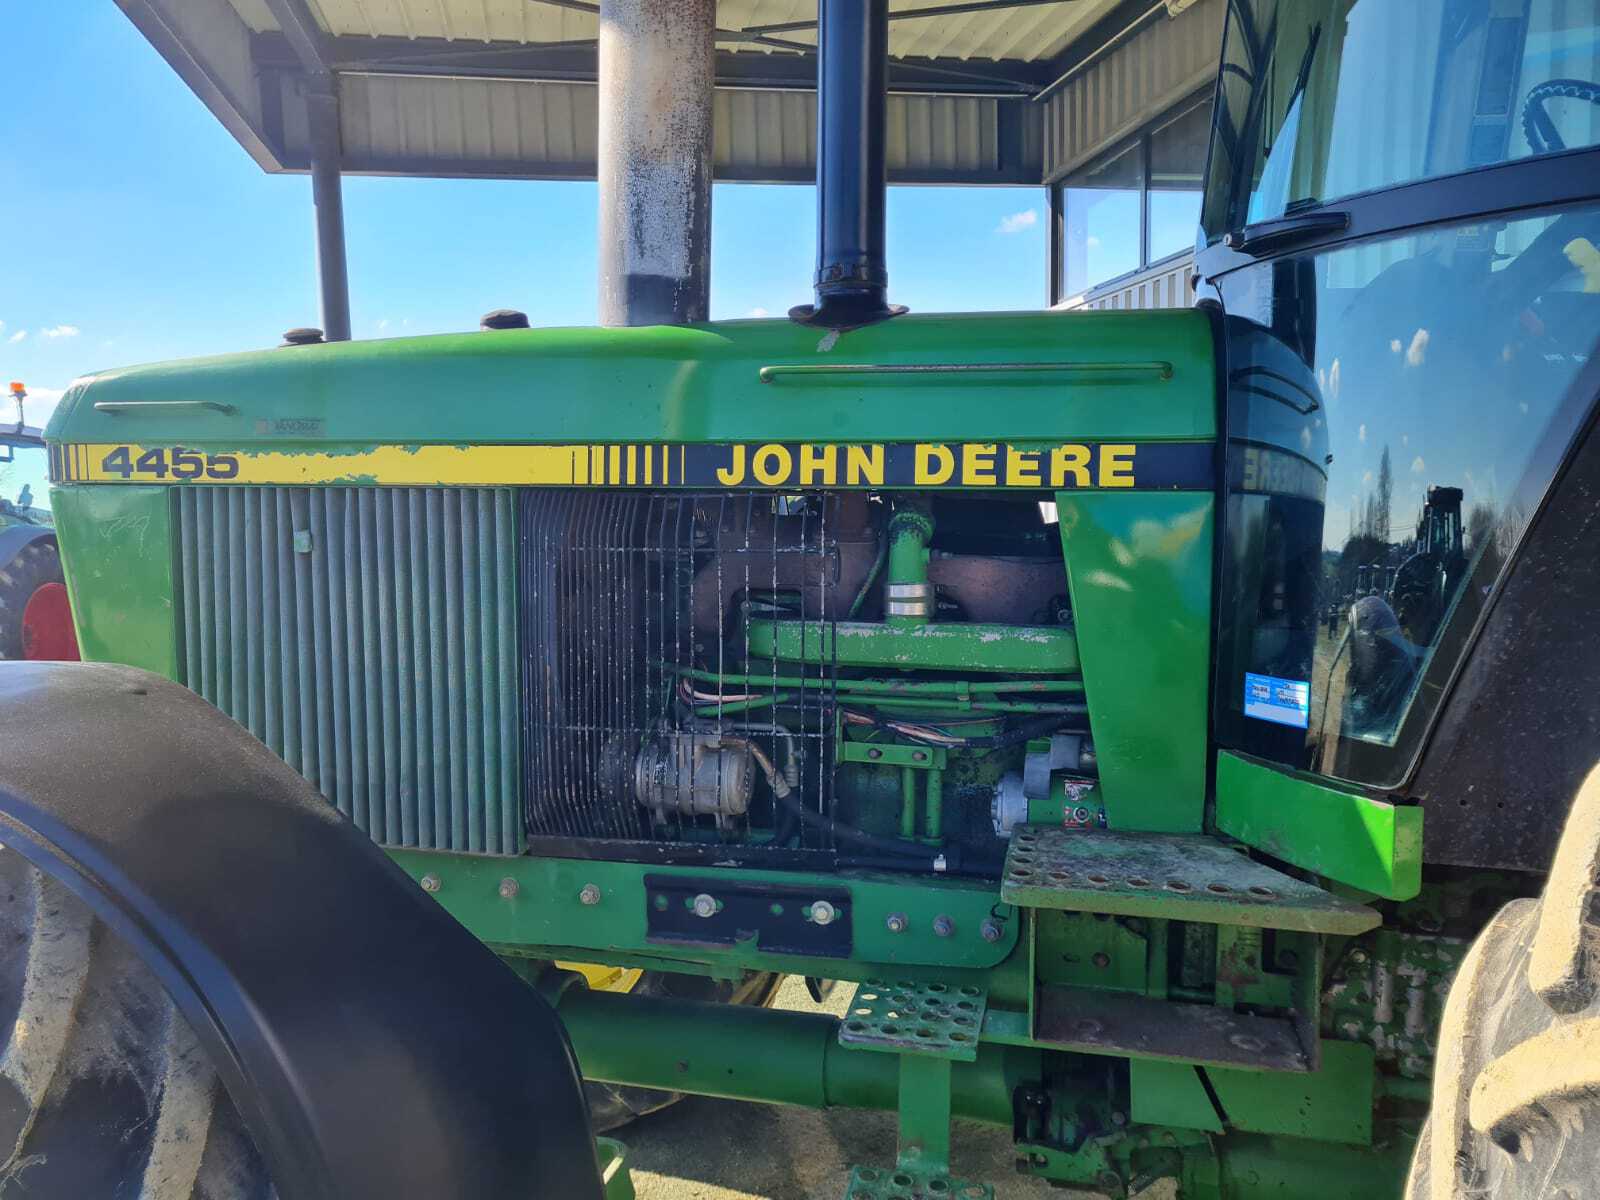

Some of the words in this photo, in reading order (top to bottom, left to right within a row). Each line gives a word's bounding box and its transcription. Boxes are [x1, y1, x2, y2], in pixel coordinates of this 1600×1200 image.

[101, 446, 239, 479] 4455
[716, 443, 885, 486] JOHN
[914, 443, 1137, 488] DEERE
